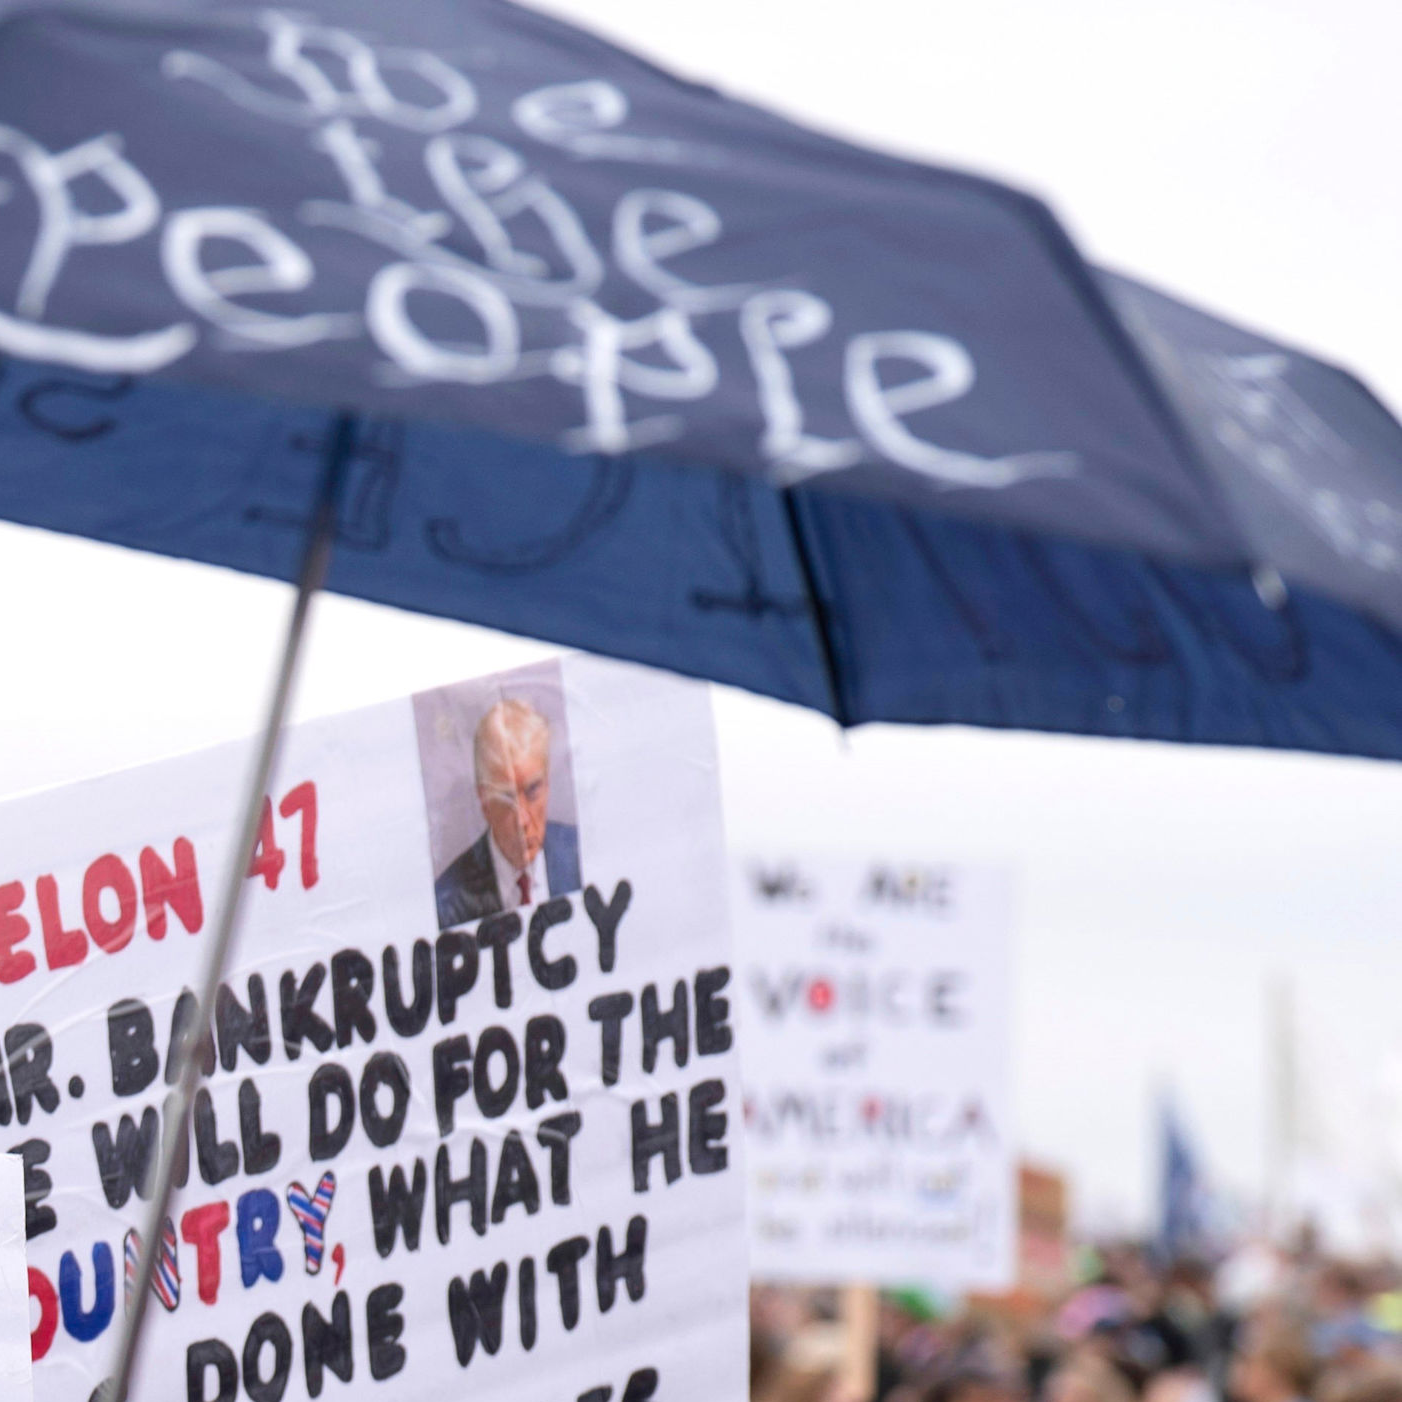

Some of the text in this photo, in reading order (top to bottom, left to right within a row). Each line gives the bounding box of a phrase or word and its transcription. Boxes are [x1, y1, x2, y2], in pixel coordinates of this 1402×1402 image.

[246, 780, 319, 891] 47
[92, 1076, 282, 1209] WILL
[308, 1051, 410, 1162] DO
[433, 1013, 568, 1136] FOR
[587, 965, 734, 1088] THE
[107, 878, 632, 1097] BANKRUPTCY
[28, 1077, 729, 1363] OUNTRY, WHAT HE
[447, 1214, 649, 1369] WITH
